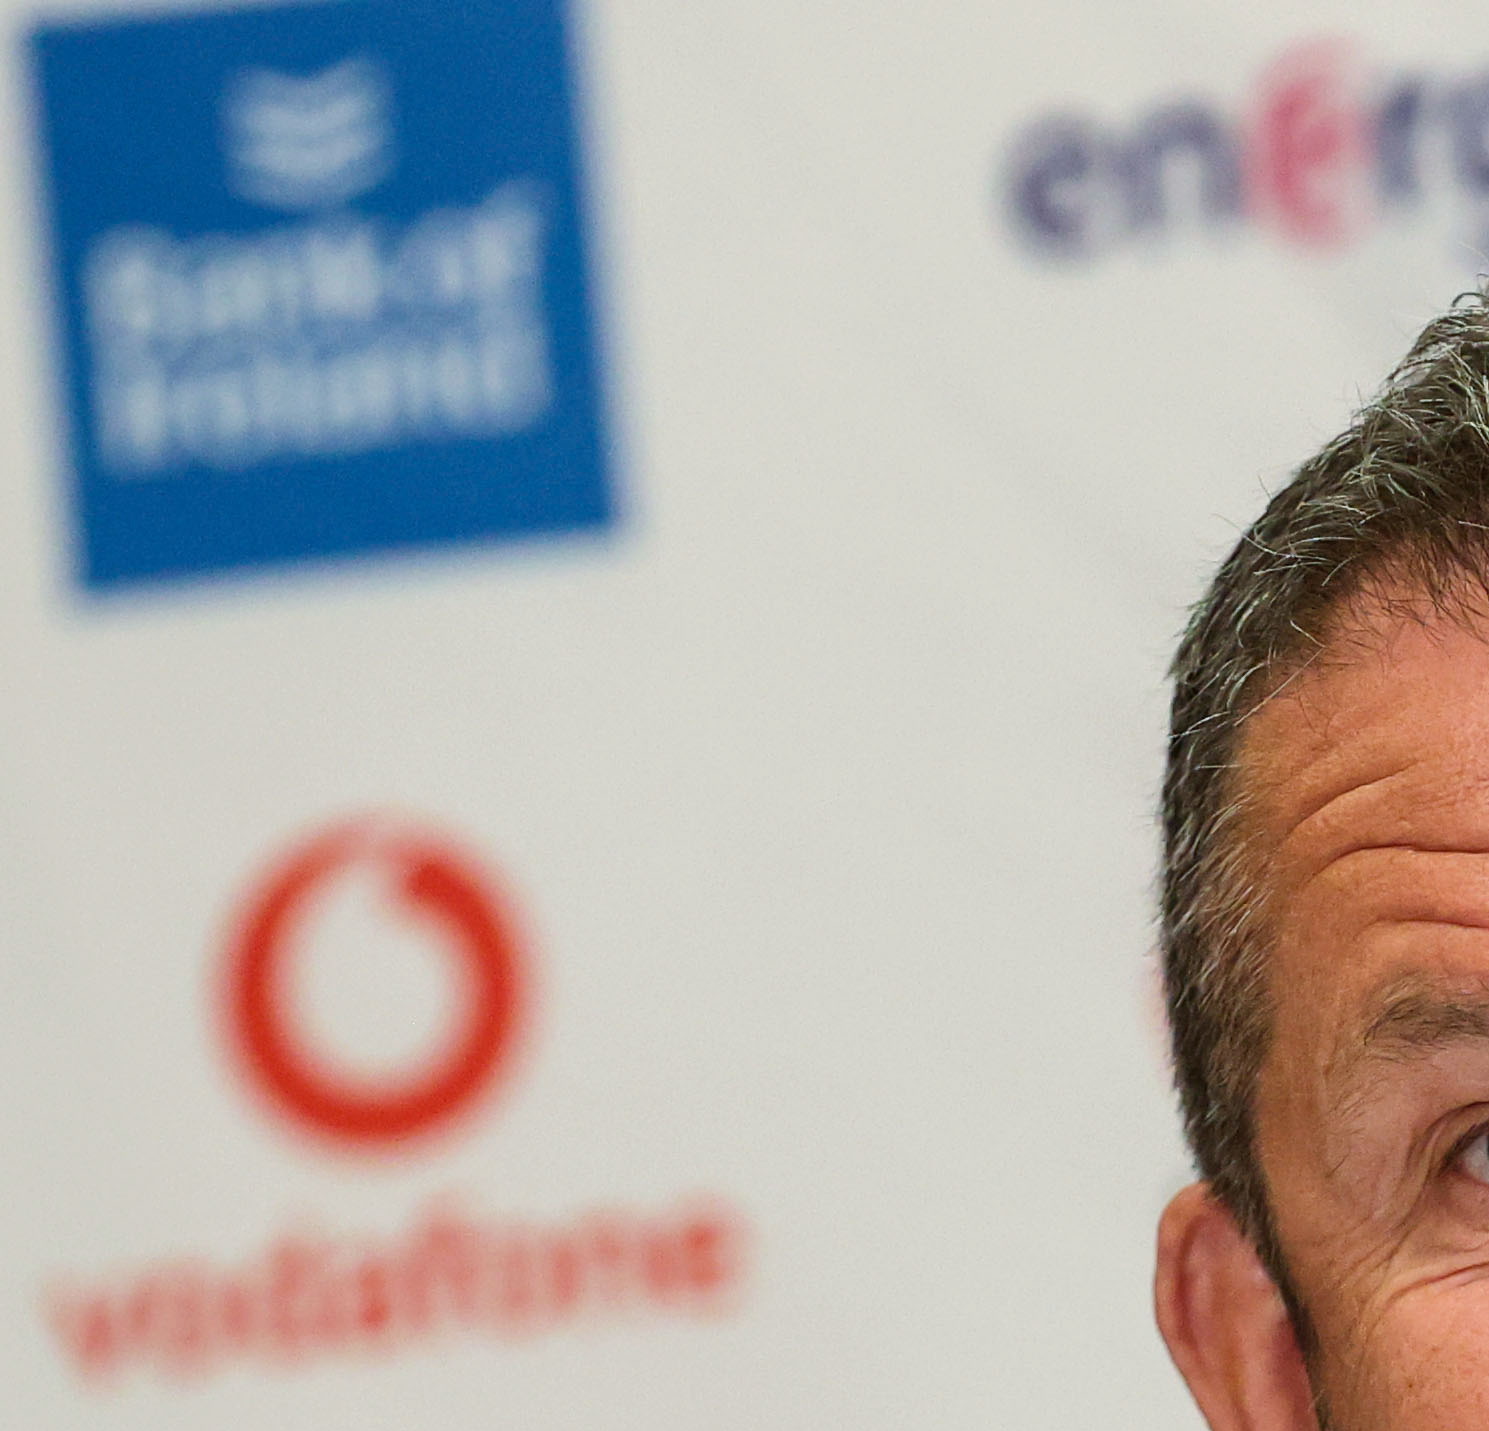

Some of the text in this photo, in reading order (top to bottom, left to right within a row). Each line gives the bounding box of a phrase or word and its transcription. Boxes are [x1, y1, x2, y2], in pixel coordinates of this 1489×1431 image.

[86, 183, 550, 338] Bank of
[97, 332, 550, 475] Ireland
[40, 1195, 745, 1385] vodafone
